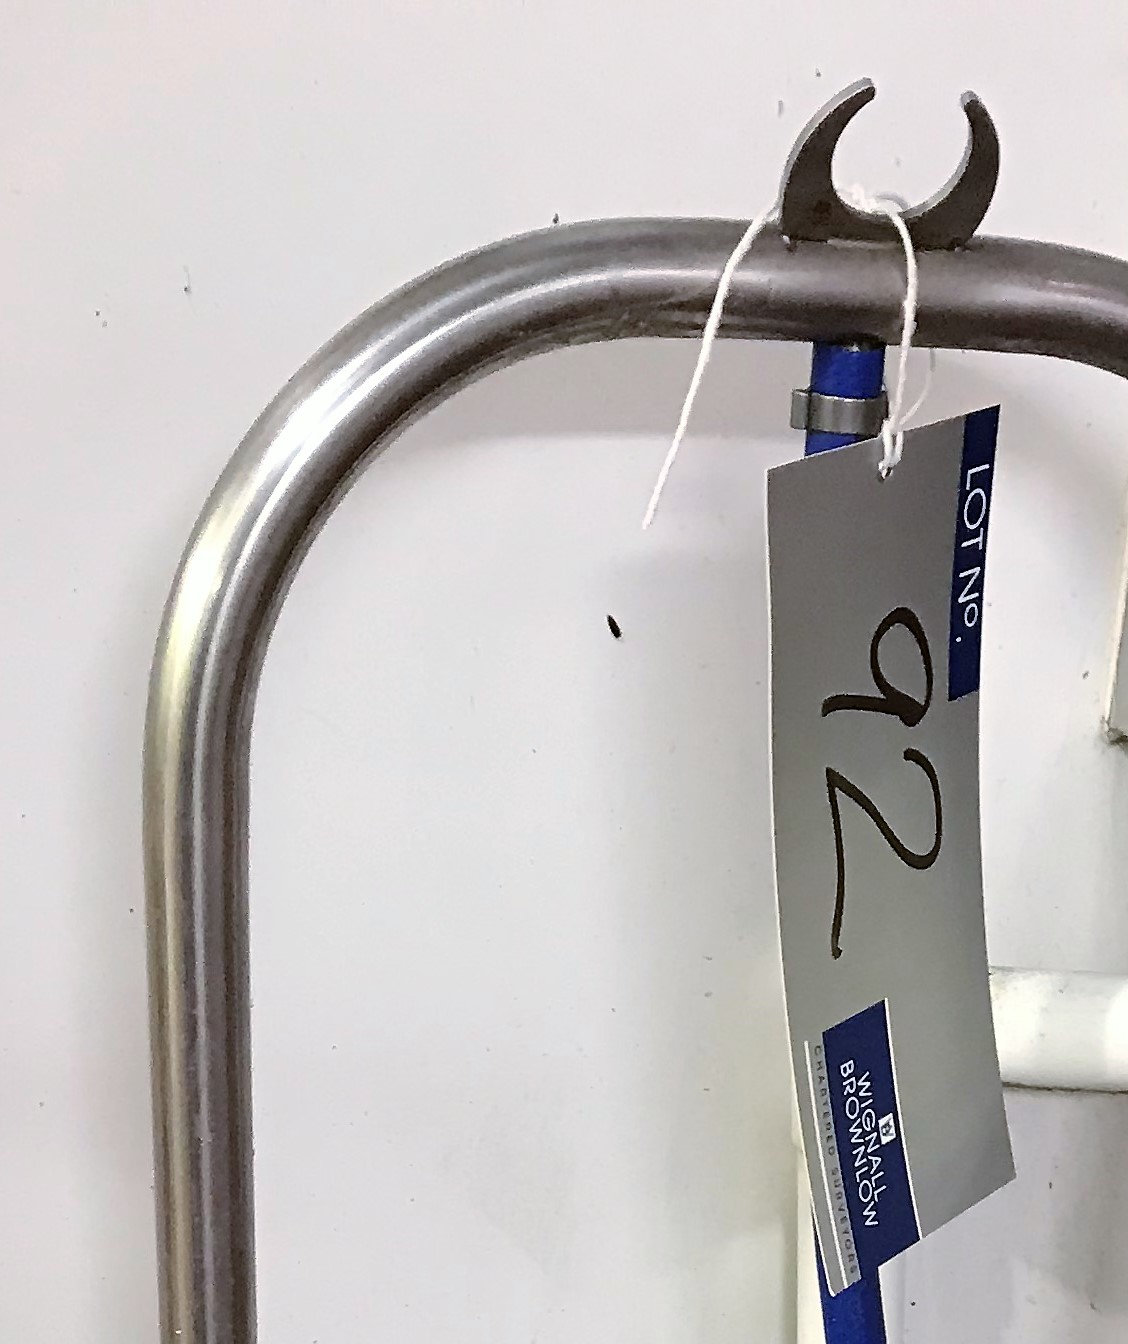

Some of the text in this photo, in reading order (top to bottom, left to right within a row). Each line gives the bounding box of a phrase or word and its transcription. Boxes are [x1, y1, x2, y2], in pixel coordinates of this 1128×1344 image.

[960, 463, 991, 550] LOT
[820, 605, 943, 961] 92
[813, 1045, 857, 1275] CHARTERED SURVEYORS
[839, 1058, 880, 1227] BROWNLOW
[857, 1070, 888, 1203] WIGNALL
